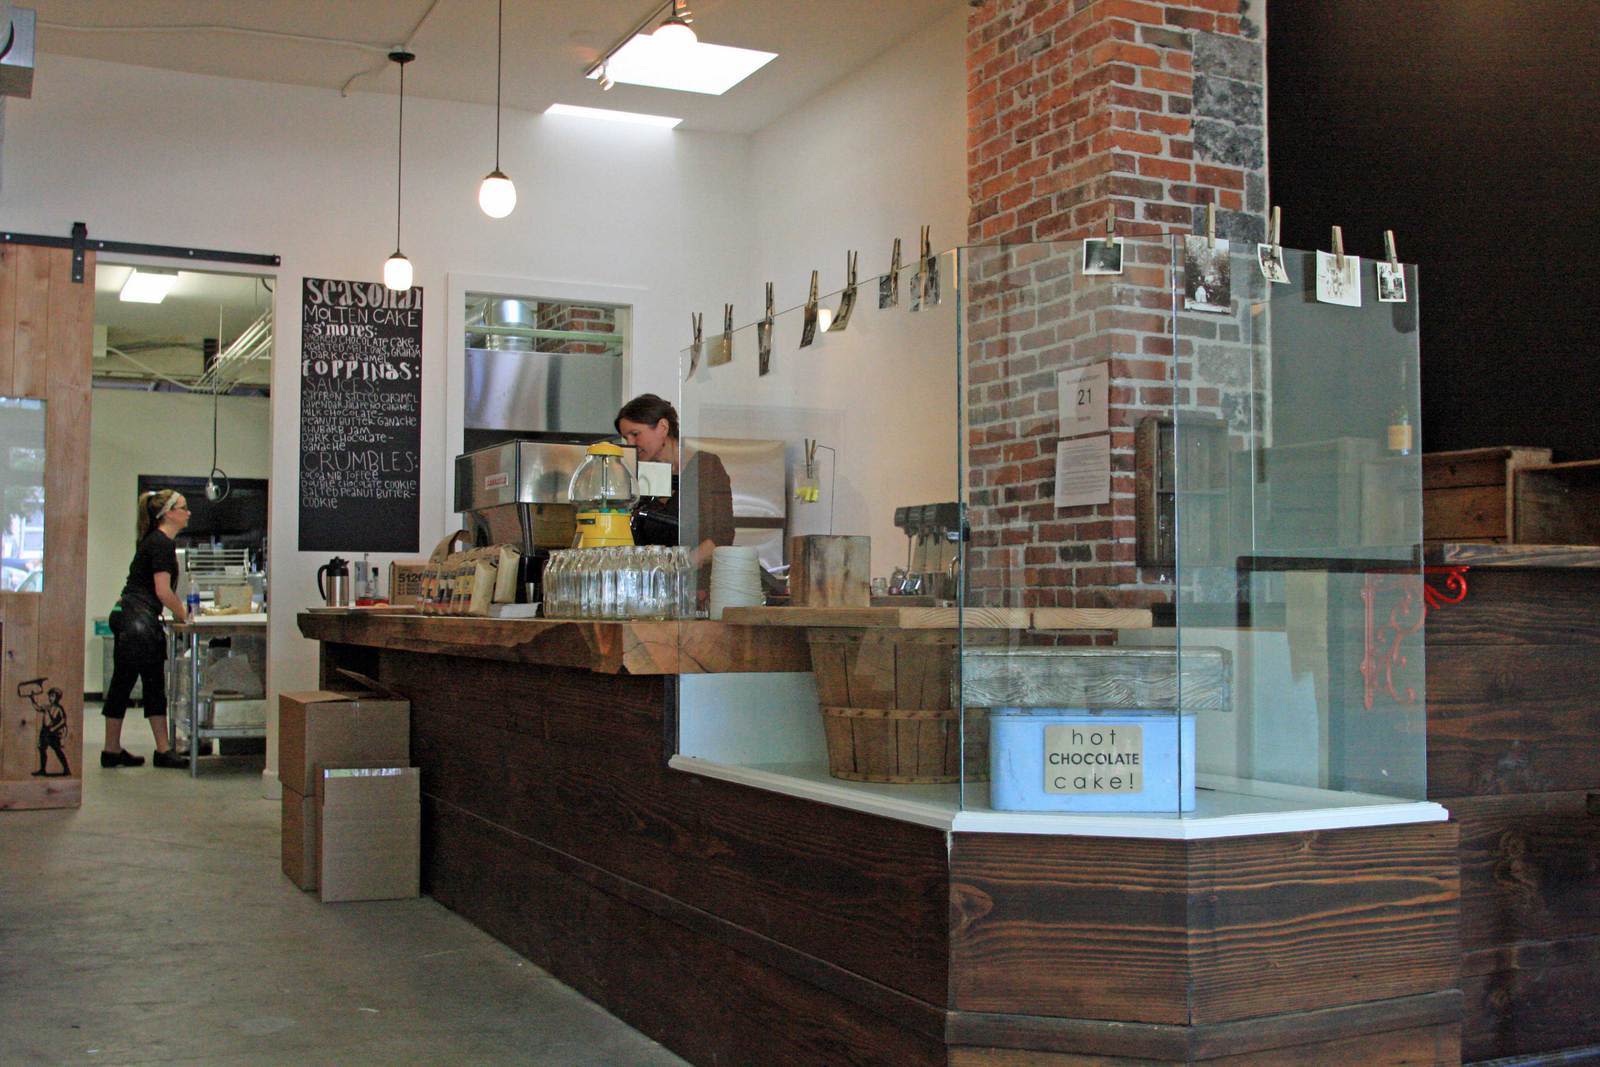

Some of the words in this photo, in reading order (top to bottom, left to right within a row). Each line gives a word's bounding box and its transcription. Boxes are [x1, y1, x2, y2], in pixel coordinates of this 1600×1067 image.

[304, 304, 369, 324] MOLTEN
[372, 308, 419, 328] CAKE
[303, 360, 419, 381] TOPPINGS:
[1078, 388, 1091, 405] 21
[303, 450, 419, 472] CRUMBLES:
[1072, 729, 1117, 745] hot
[1049, 753, 1140, 765] CHOCOLATE
[1054, 772, 1134, 789] cake!
